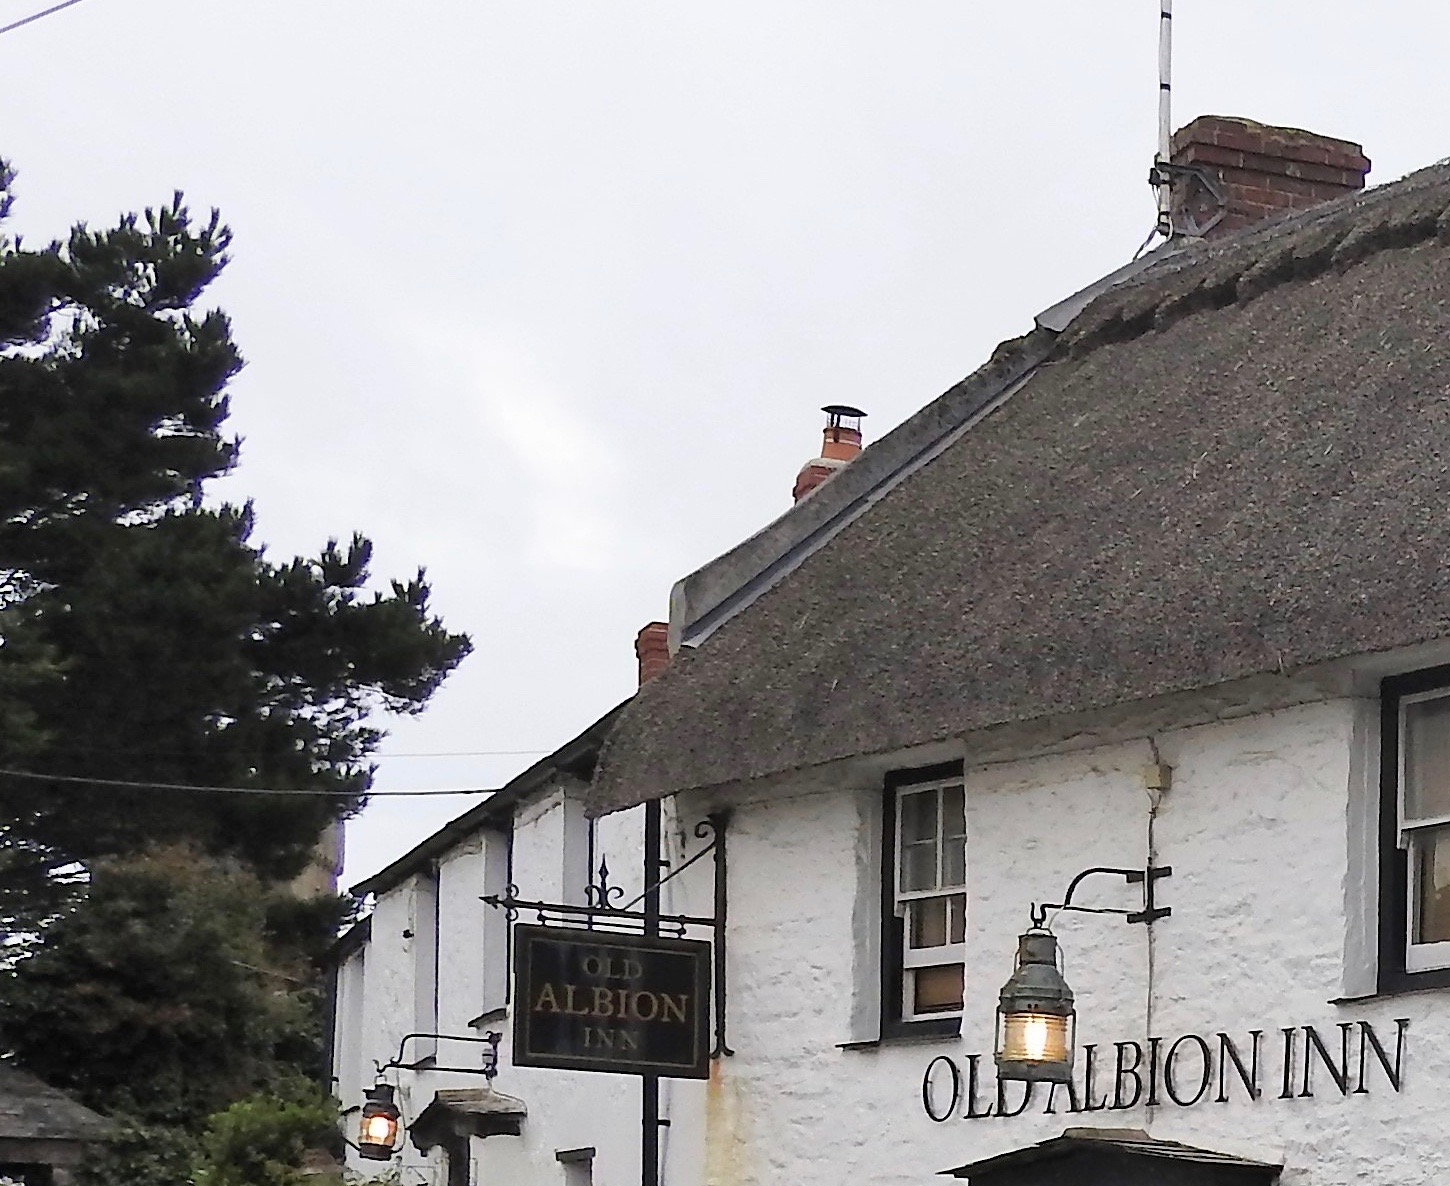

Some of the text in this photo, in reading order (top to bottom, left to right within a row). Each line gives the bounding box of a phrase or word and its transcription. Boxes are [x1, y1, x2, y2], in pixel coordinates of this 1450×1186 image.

[583, 954, 644, 980] OLD
[533, 982, 690, 1024] ALBION
[583, 1026, 640, 1051] INN
[1277, 1018, 1410, 1099] INN
